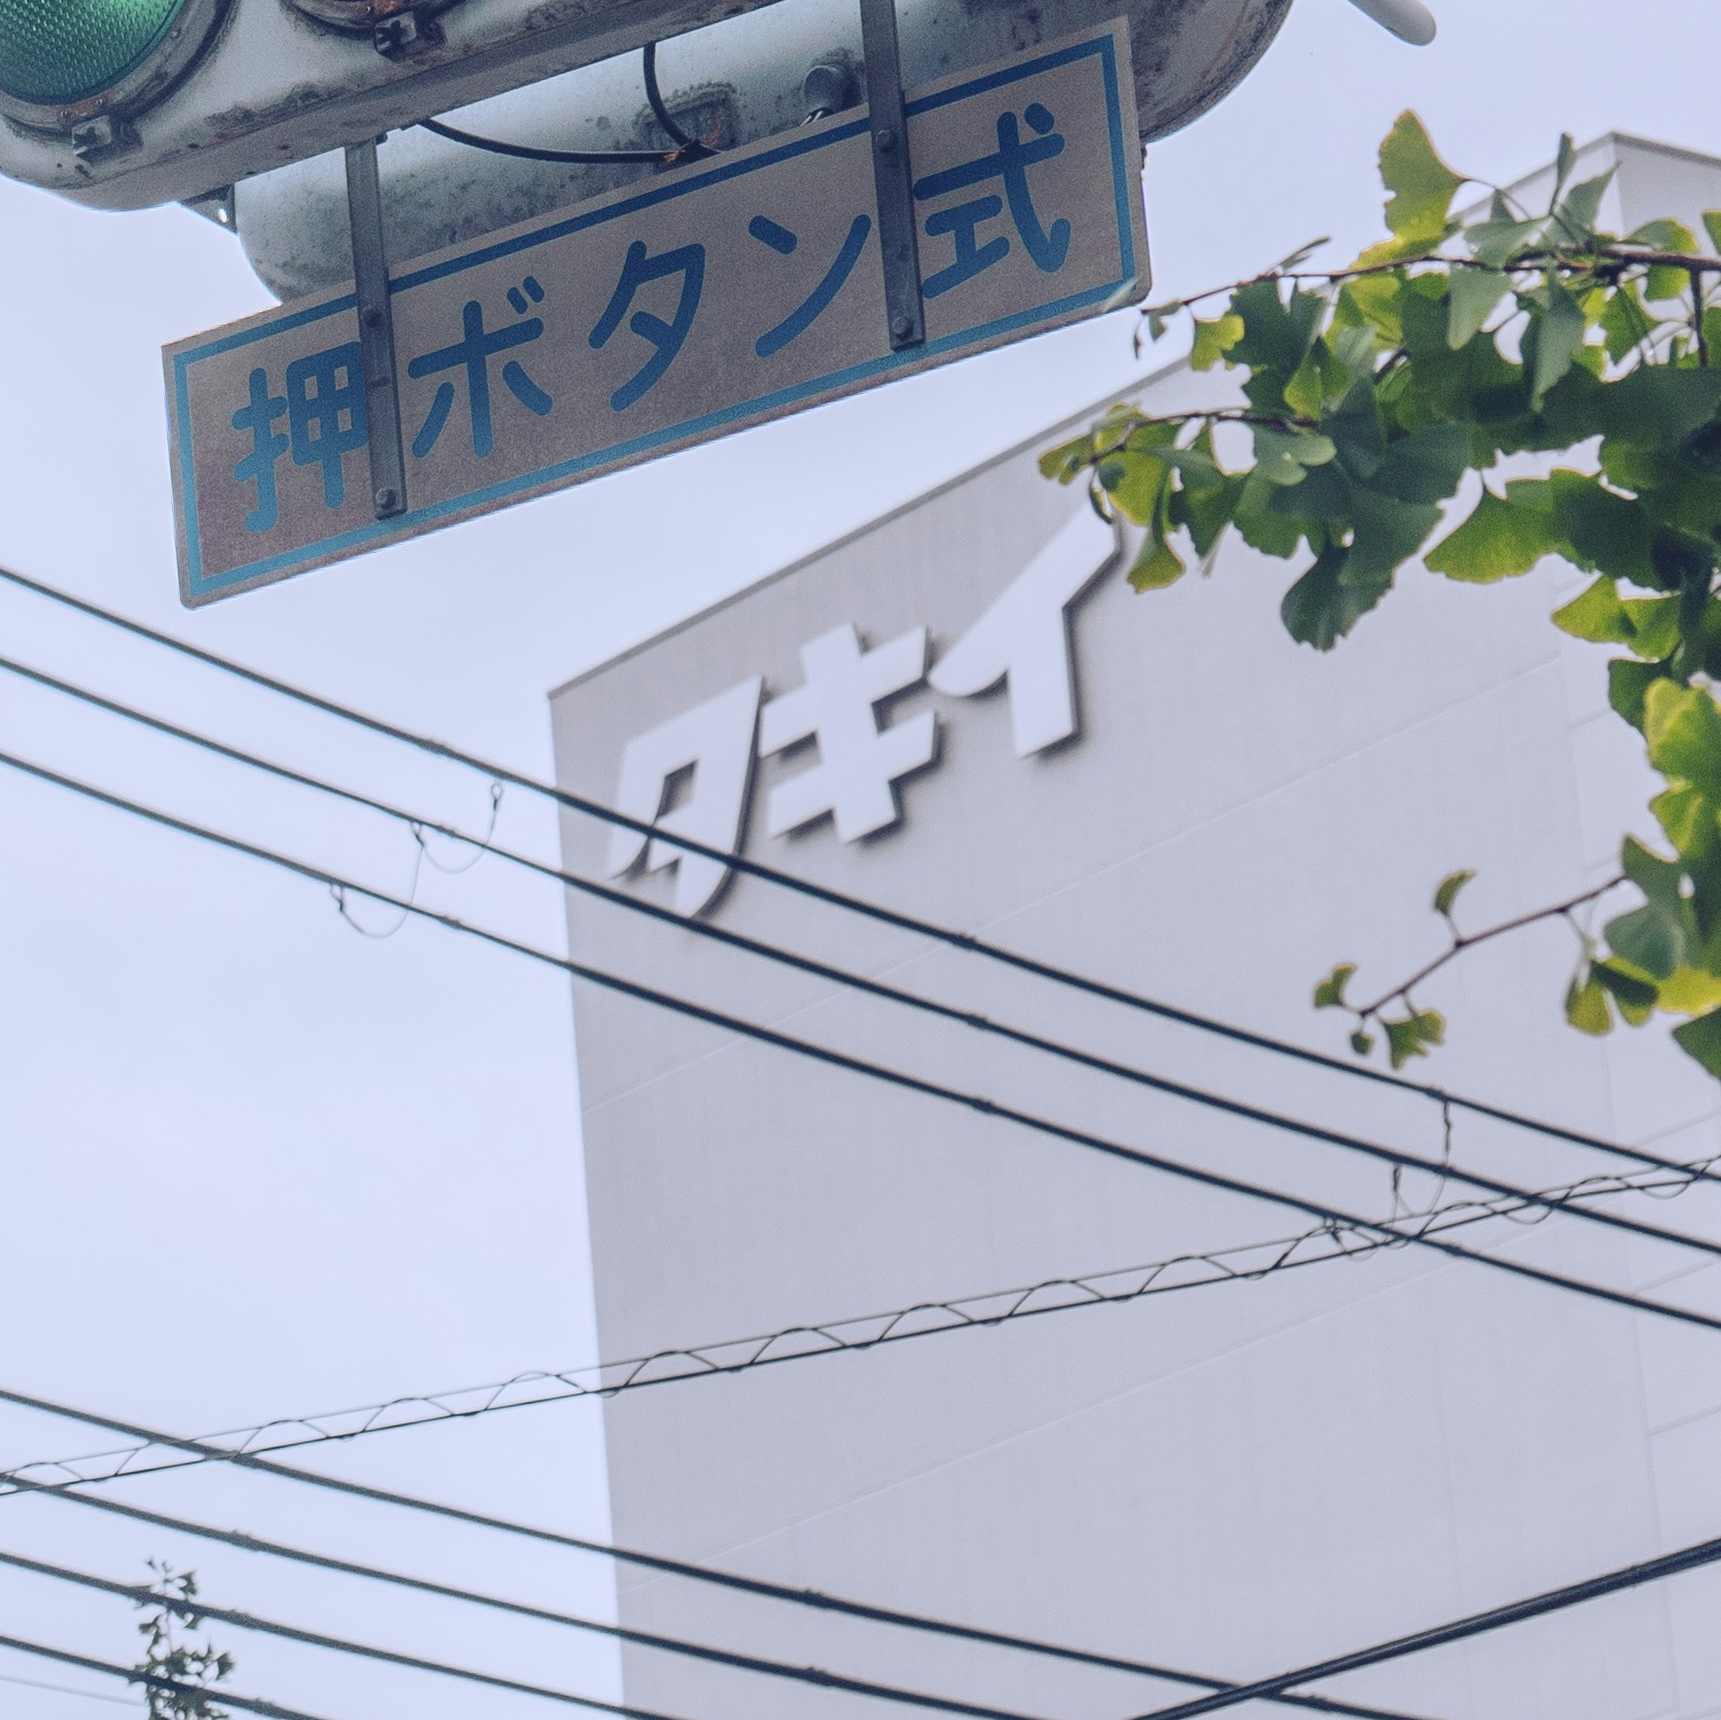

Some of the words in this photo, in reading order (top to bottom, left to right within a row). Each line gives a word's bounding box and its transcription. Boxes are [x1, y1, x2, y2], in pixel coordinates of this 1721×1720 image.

[231, 102, 1072, 533] 押ボタン式
[605, 501, 1122, 921] タキイ
